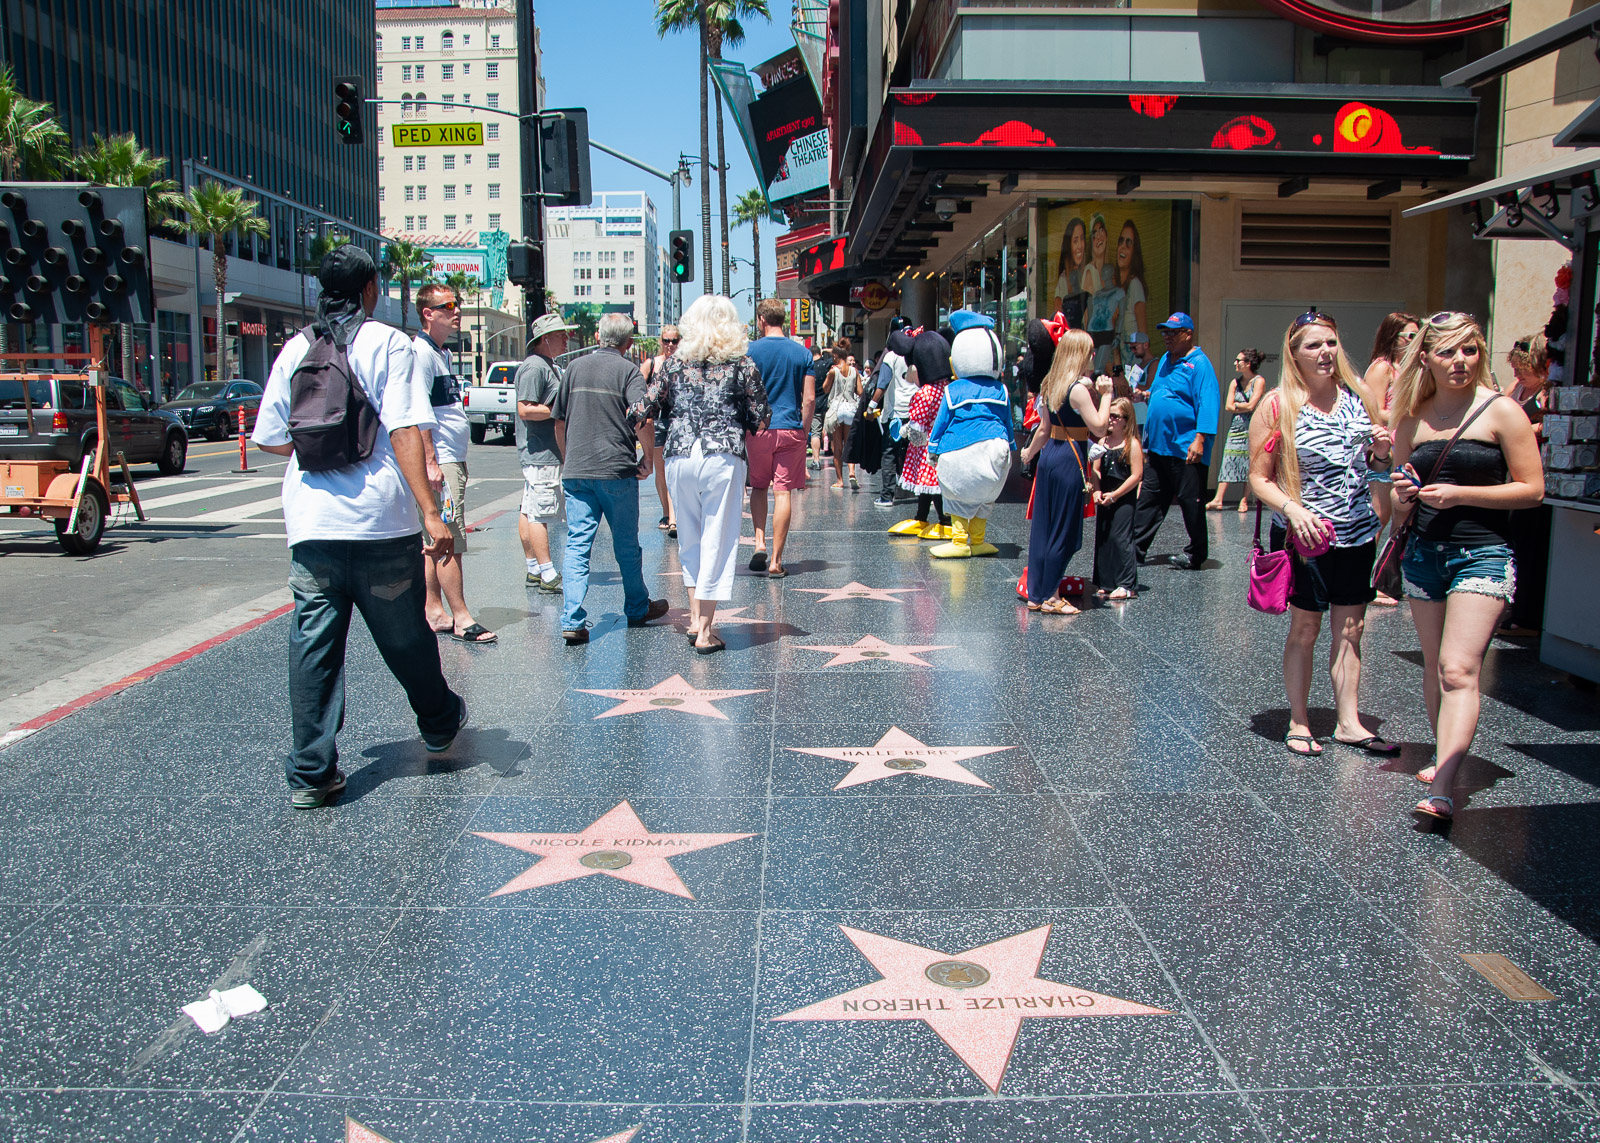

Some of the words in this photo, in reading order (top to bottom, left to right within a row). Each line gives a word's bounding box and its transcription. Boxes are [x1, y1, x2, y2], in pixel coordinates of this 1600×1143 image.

[399, 128, 431, 143] PED
[439, 127, 477, 142] XING
[766, 119, 801, 142] APARTMENT
[790, 130, 828, 156] CHINESE
[446, 263, 480, 272] DONOVAN
[241, 321, 267, 336] HOOTERS
[842, 749, 896, 757] HALLE
[904, 749, 960, 757] BERRY
[529, 837, 601, 847] NICOLE
[613, 837, 692, 847] KIDMAN
[842, 997, 952, 1013] THERON
[965, 994, 1096, 1010] CHARLIZE
